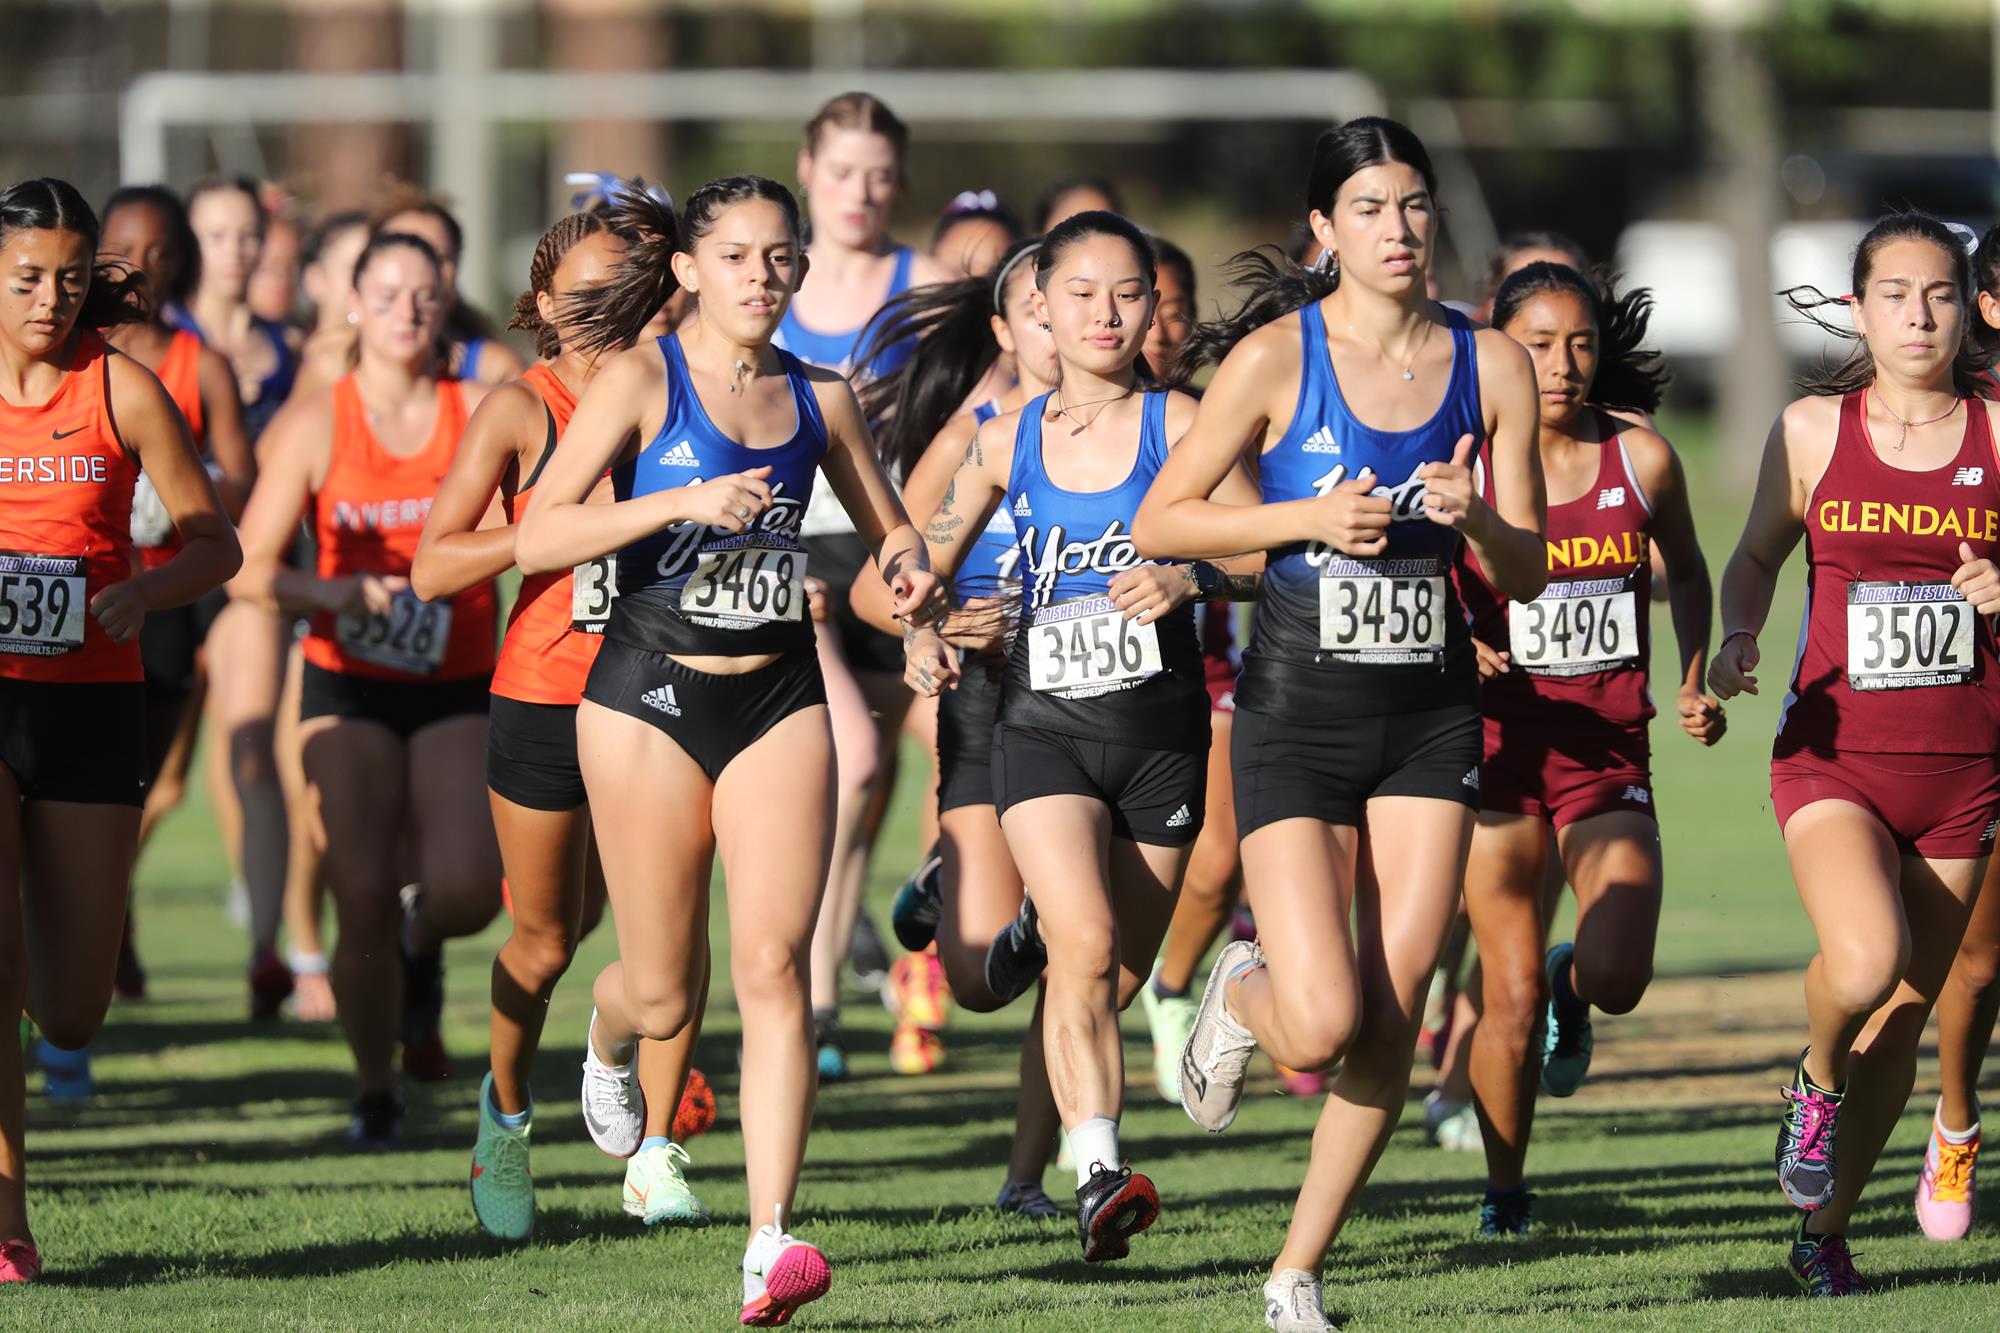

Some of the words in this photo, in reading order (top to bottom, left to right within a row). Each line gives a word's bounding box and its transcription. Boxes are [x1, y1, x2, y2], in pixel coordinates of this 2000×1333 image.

[1302, 442, 1341, 455] adidas
[659, 455, 700, 468] adidas
[1819, 501, 1998, 542] GLENDALE
[22, 557, 77, 576] RESULTS
[1021, 519, 1172, 609] Yote
[1326, 556, 1383, 577] FINISHED
[1384, 558, 1438, 577] RESULTS
[696, 551, 794, 616] 3468
[1570, 577, 1625, 598] RESULTS
[1855, 584, 1910, 604] FINISHED
[0, 576, 70, 638] 539
[1034, 601, 1082, 626] FINISHED
[1336, 579, 1433, 644] 3458
[1526, 598, 1619, 661] 3496
[1863, 604, 1961, 669] 3502
[1043, 611, 1143, 684] 3456
[1861, 673, 1962, 688] WWW.FINISHEDRESULTS.COM
[641, 693, 682, 717] adidas
